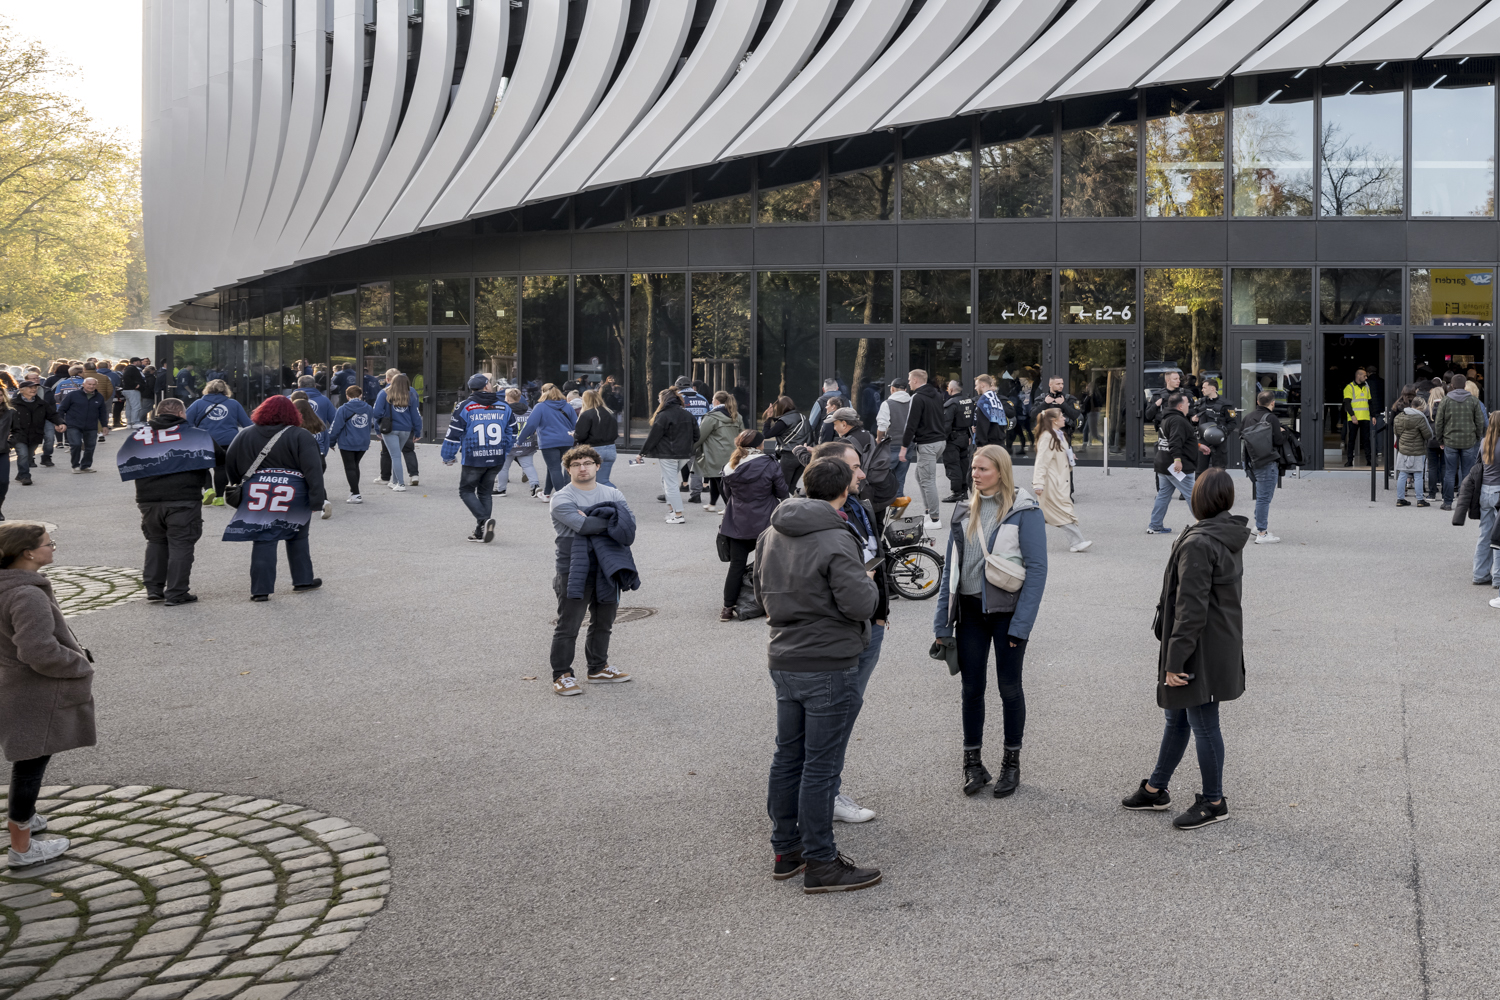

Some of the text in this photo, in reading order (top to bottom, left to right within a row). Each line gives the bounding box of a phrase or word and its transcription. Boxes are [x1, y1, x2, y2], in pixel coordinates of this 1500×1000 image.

[1030, 306, 1047, 320] T2
[1096, 306, 1131, 320] E2-6
[473, 423, 502, 446] 19
[259, 475, 289, 484] HAGER
[248, 483, 295, 512] 52
